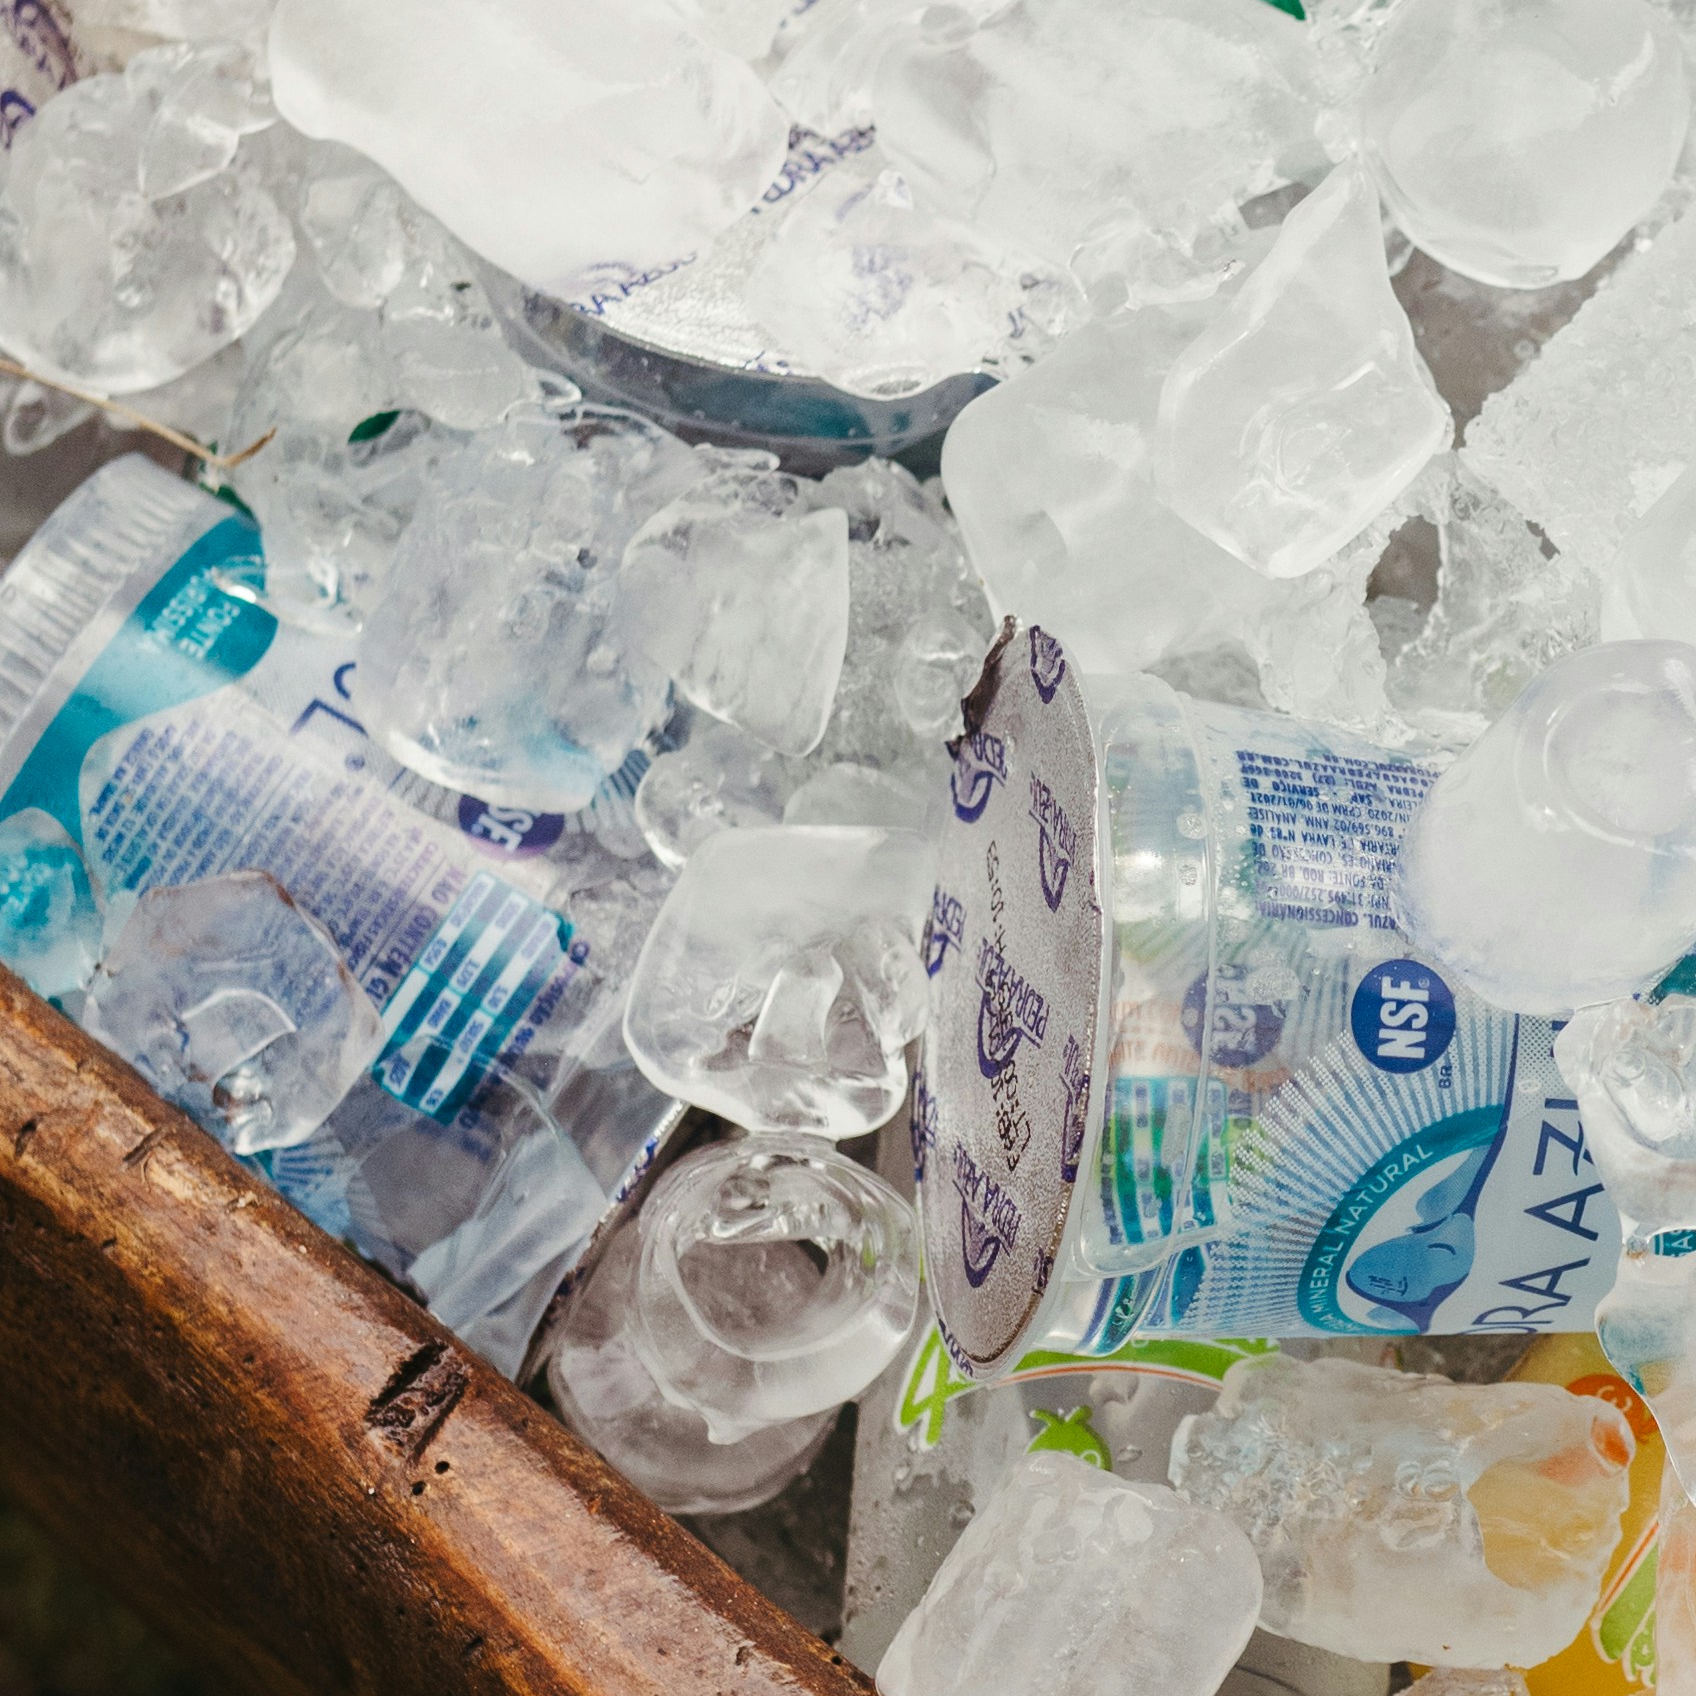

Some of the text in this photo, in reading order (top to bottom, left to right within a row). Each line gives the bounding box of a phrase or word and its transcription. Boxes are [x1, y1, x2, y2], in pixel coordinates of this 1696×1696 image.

[177, 599, 241, 662] FONTE
[1240, 775, 1260, 789] DE
[1270, 777, 1320, 798] SERVIÇO
[1349, 791, 1374, 807] SAP
[475, 806, 543, 852] SF
[1329, 802, 1362, 817] CPRM
[427, 862, 469, 908] NÃO
[377, 900, 446, 984] CONTÉM
[1010, 975, 1050, 1041] PEDRA
[1375, 976, 1432, 1061] NSF
[1438, 1065, 1453, 1089] BR
[979, 1175, 1023, 1252] PEDRA
[1309, 1240, 1345, 1315] MINERAL
[1334, 1144, 1434, 1236] NATURAL
